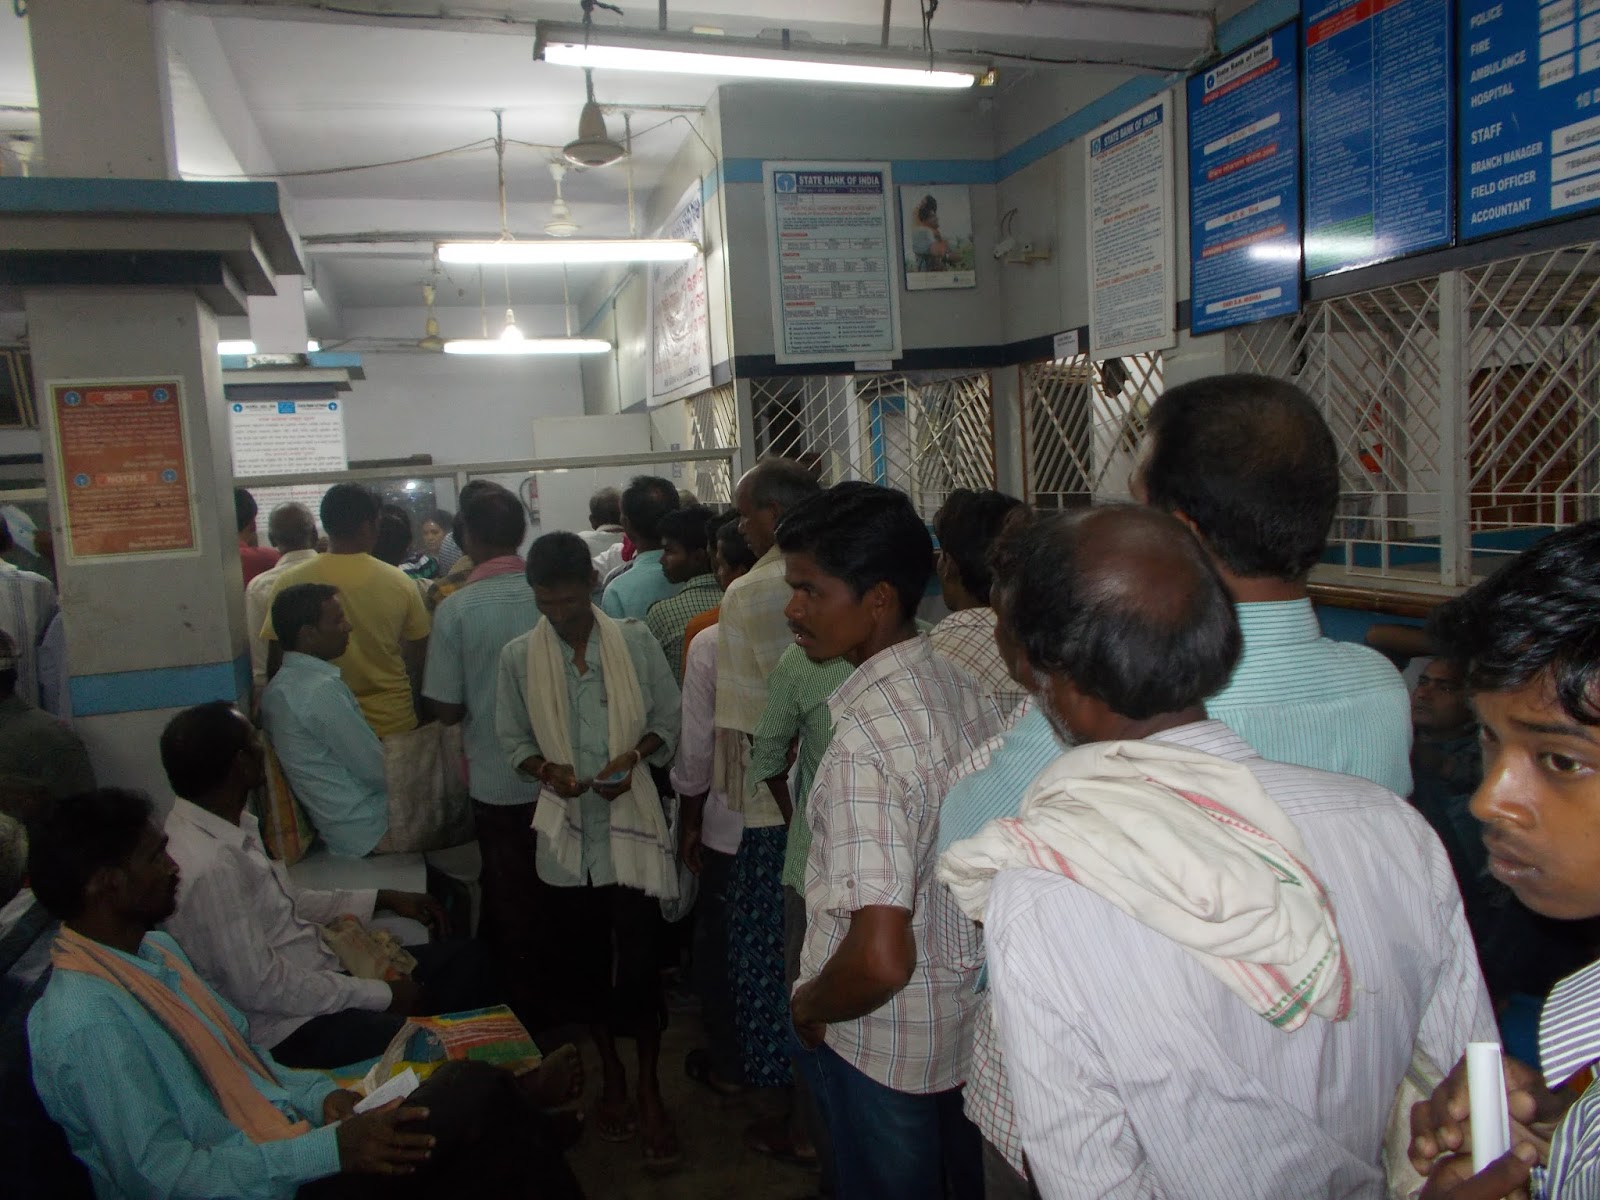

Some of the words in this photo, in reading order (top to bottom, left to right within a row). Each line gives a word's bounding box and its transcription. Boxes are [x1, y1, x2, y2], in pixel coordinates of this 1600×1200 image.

[1470, 38, 1490, 57] FIRE
[1216, 64, 1229, 78] State
[1231, 58, 1244, 70] Bank
[1246, 53, 1253, 62] of
[1253, 45, 1269, 60] India
[1470, 50, 1526, 83] AMBULANCE
[1470, 82, 1514, 108] HOSPITAL
[1104, 130, 1119, 147] STATE
[1120, 124, 1134, 139] BANK
[1135, 119, 1143, 131] OF
[1143, 111, 1158, 126] INDIA
[1471, 122, 1502, 145] STAFF
[1471, 154, 1502, 175] BRANCH
[1503, 141, 1543, 164] MANAGER
[799, 176, 822, 185] STATE
[824, 176, 846, 185] BANK
[847, 176, 857, 185] OF
[859, 175, 880, 185] INDIA
[1471, 182, 1496, 199] FIELD
[1498, 170, 1536, 191] OFFICER
[1471, 198, 1531, 223] ACCOUNTANT
